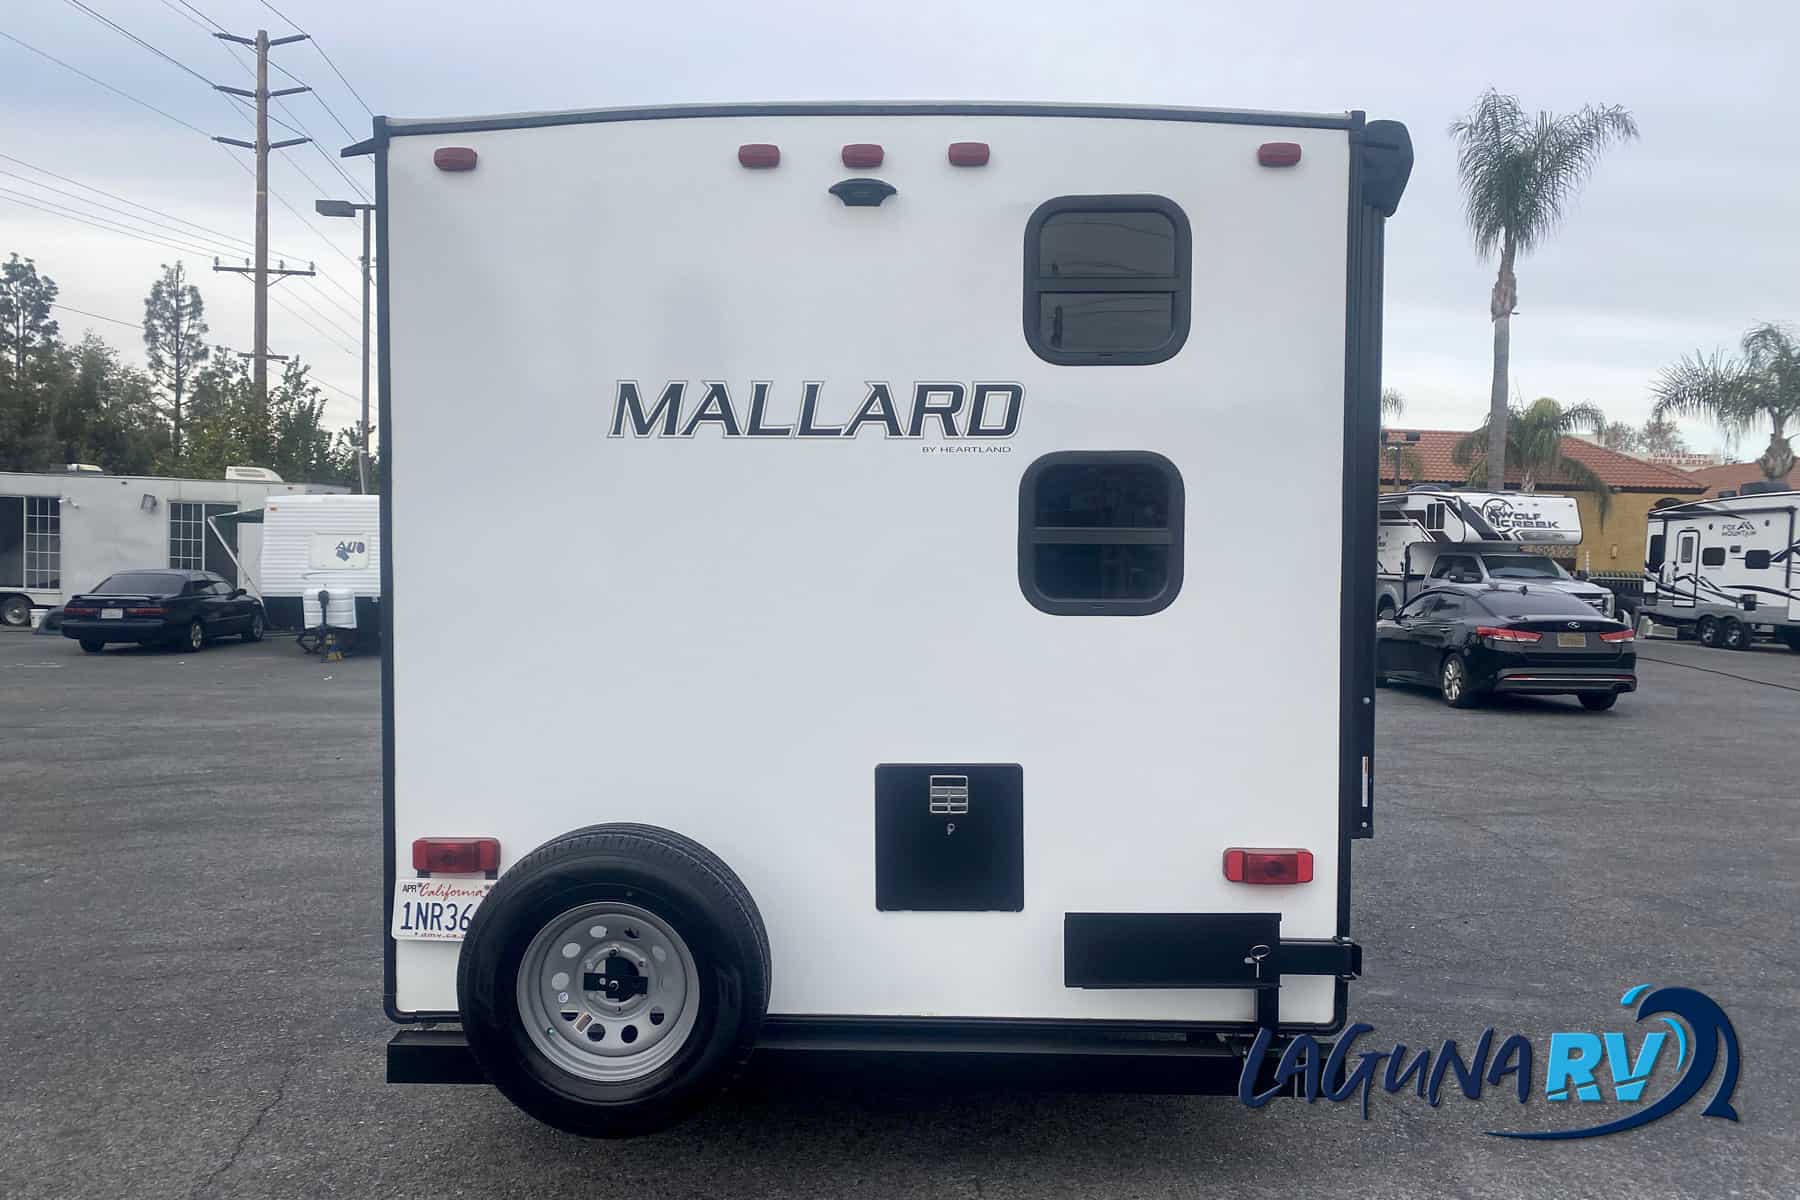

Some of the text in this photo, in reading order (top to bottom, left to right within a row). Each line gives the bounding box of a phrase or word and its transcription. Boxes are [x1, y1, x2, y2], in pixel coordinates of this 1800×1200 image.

[606, 379, 1027, 439] MALLARD
[1500, 512, 1542, 520] WOLF
[1501, 520, 1560, 528] CREEK
[402, 882, 486, 901] APR California
[400, 901, 473, 931] 1NR36
